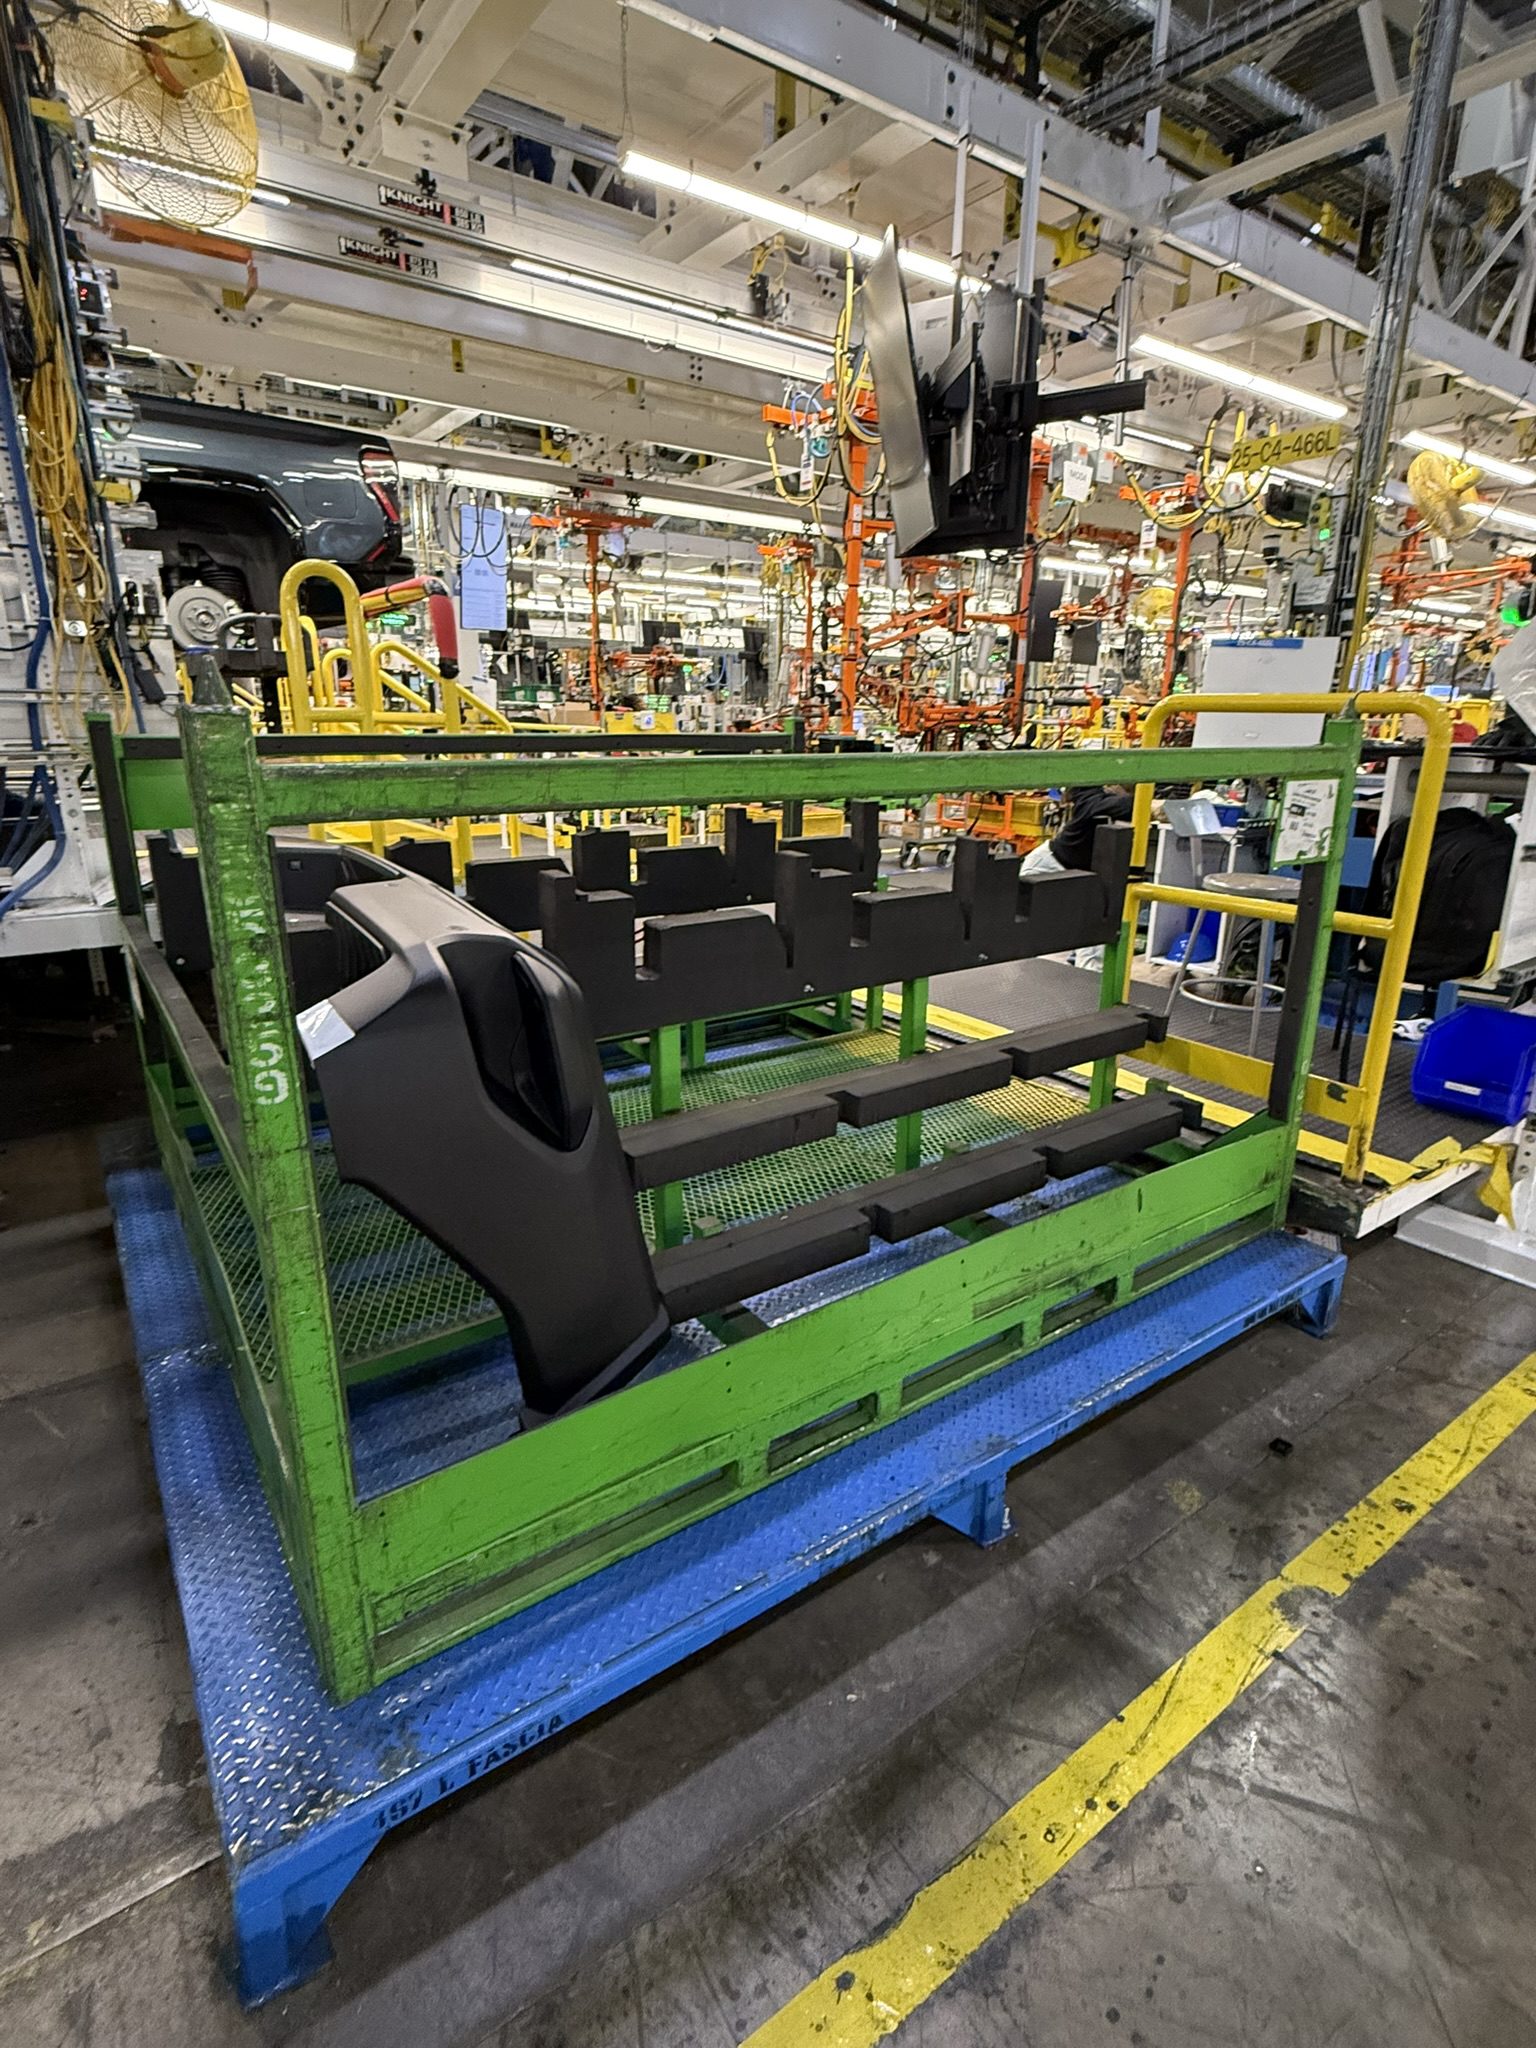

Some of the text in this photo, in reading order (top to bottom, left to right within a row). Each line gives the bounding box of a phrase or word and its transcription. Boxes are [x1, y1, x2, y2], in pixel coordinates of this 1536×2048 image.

[387, 187, 443, 212] KNIGHT
[346, 239, 398, 259] KNIGHT
[468, 1714, 565, 1778] FASCIA
